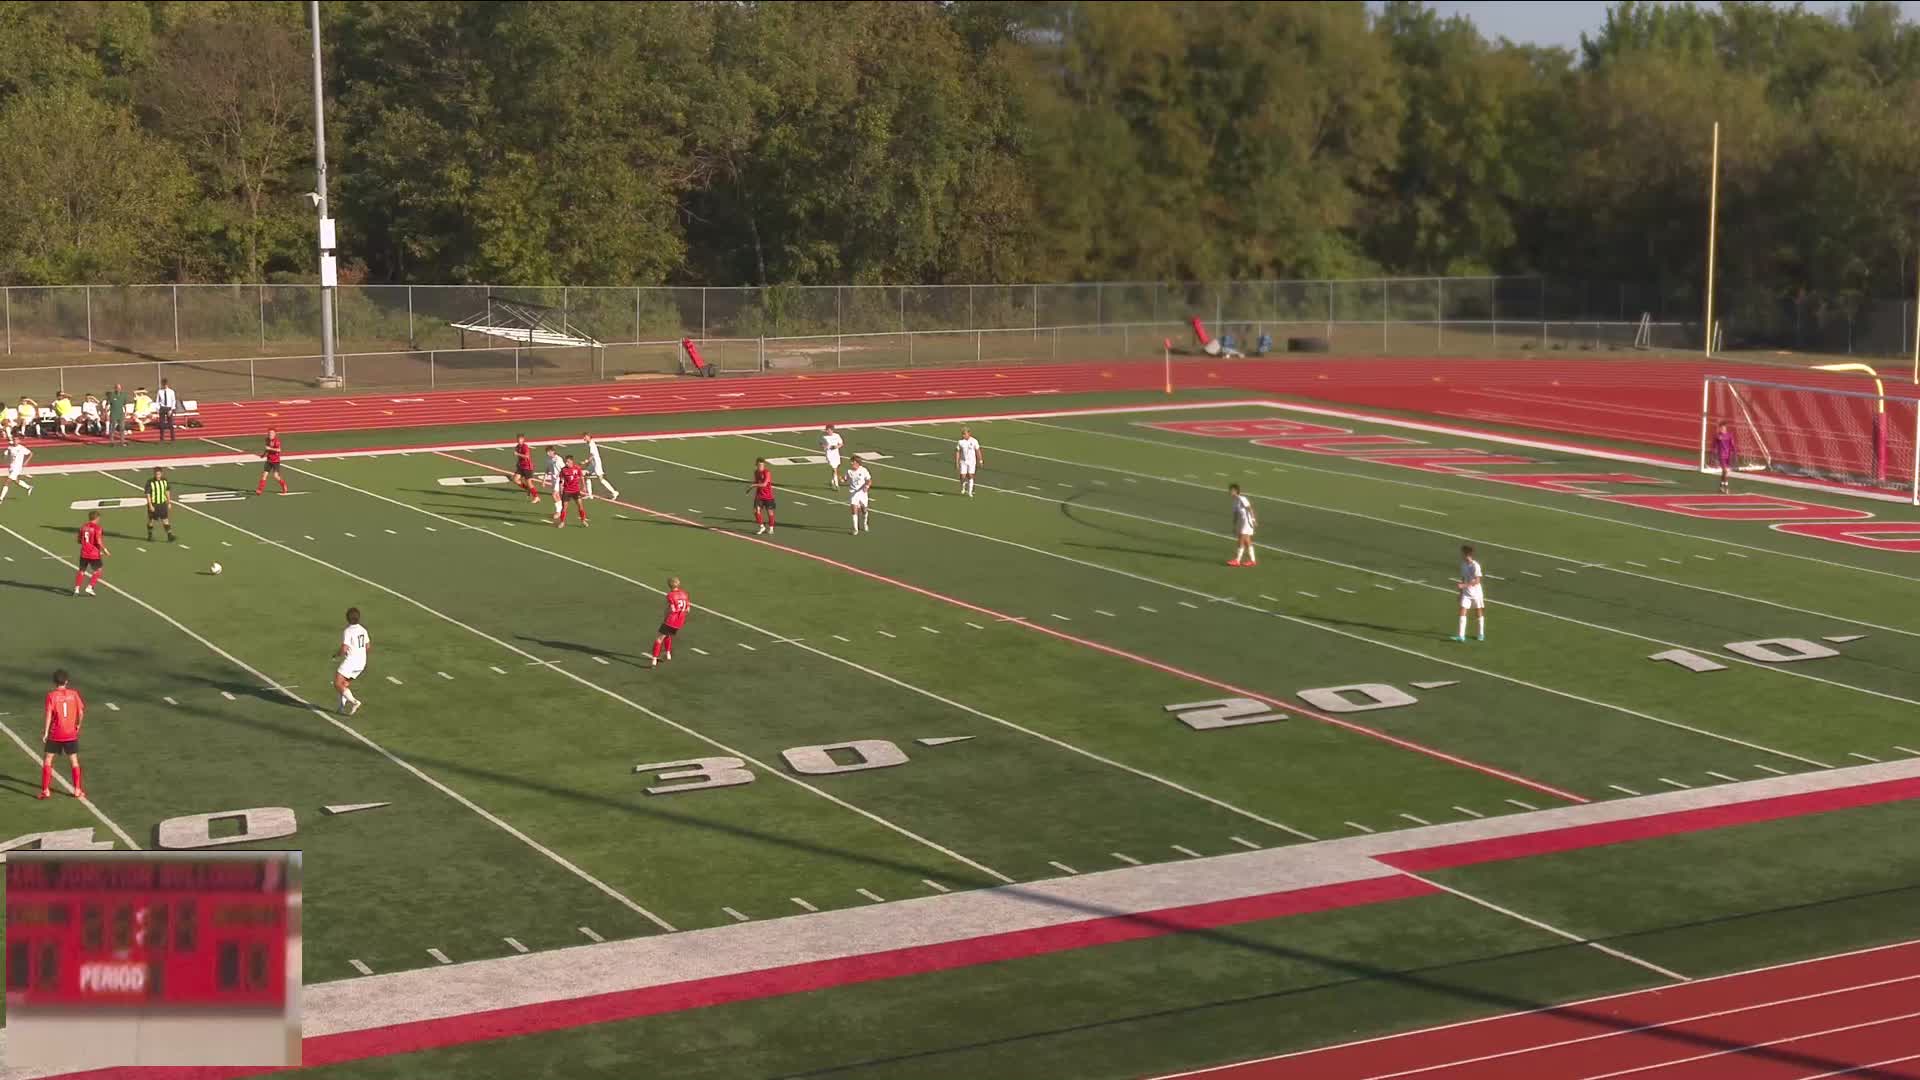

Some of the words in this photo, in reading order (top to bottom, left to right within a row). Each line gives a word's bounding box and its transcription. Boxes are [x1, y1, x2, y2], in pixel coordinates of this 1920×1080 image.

[1649, 637, 1840, 673] 10
[62, 702, 68, 717] 1
[1164, 682, 1418, 730] 20
[634, 738, 909, 795] 30
